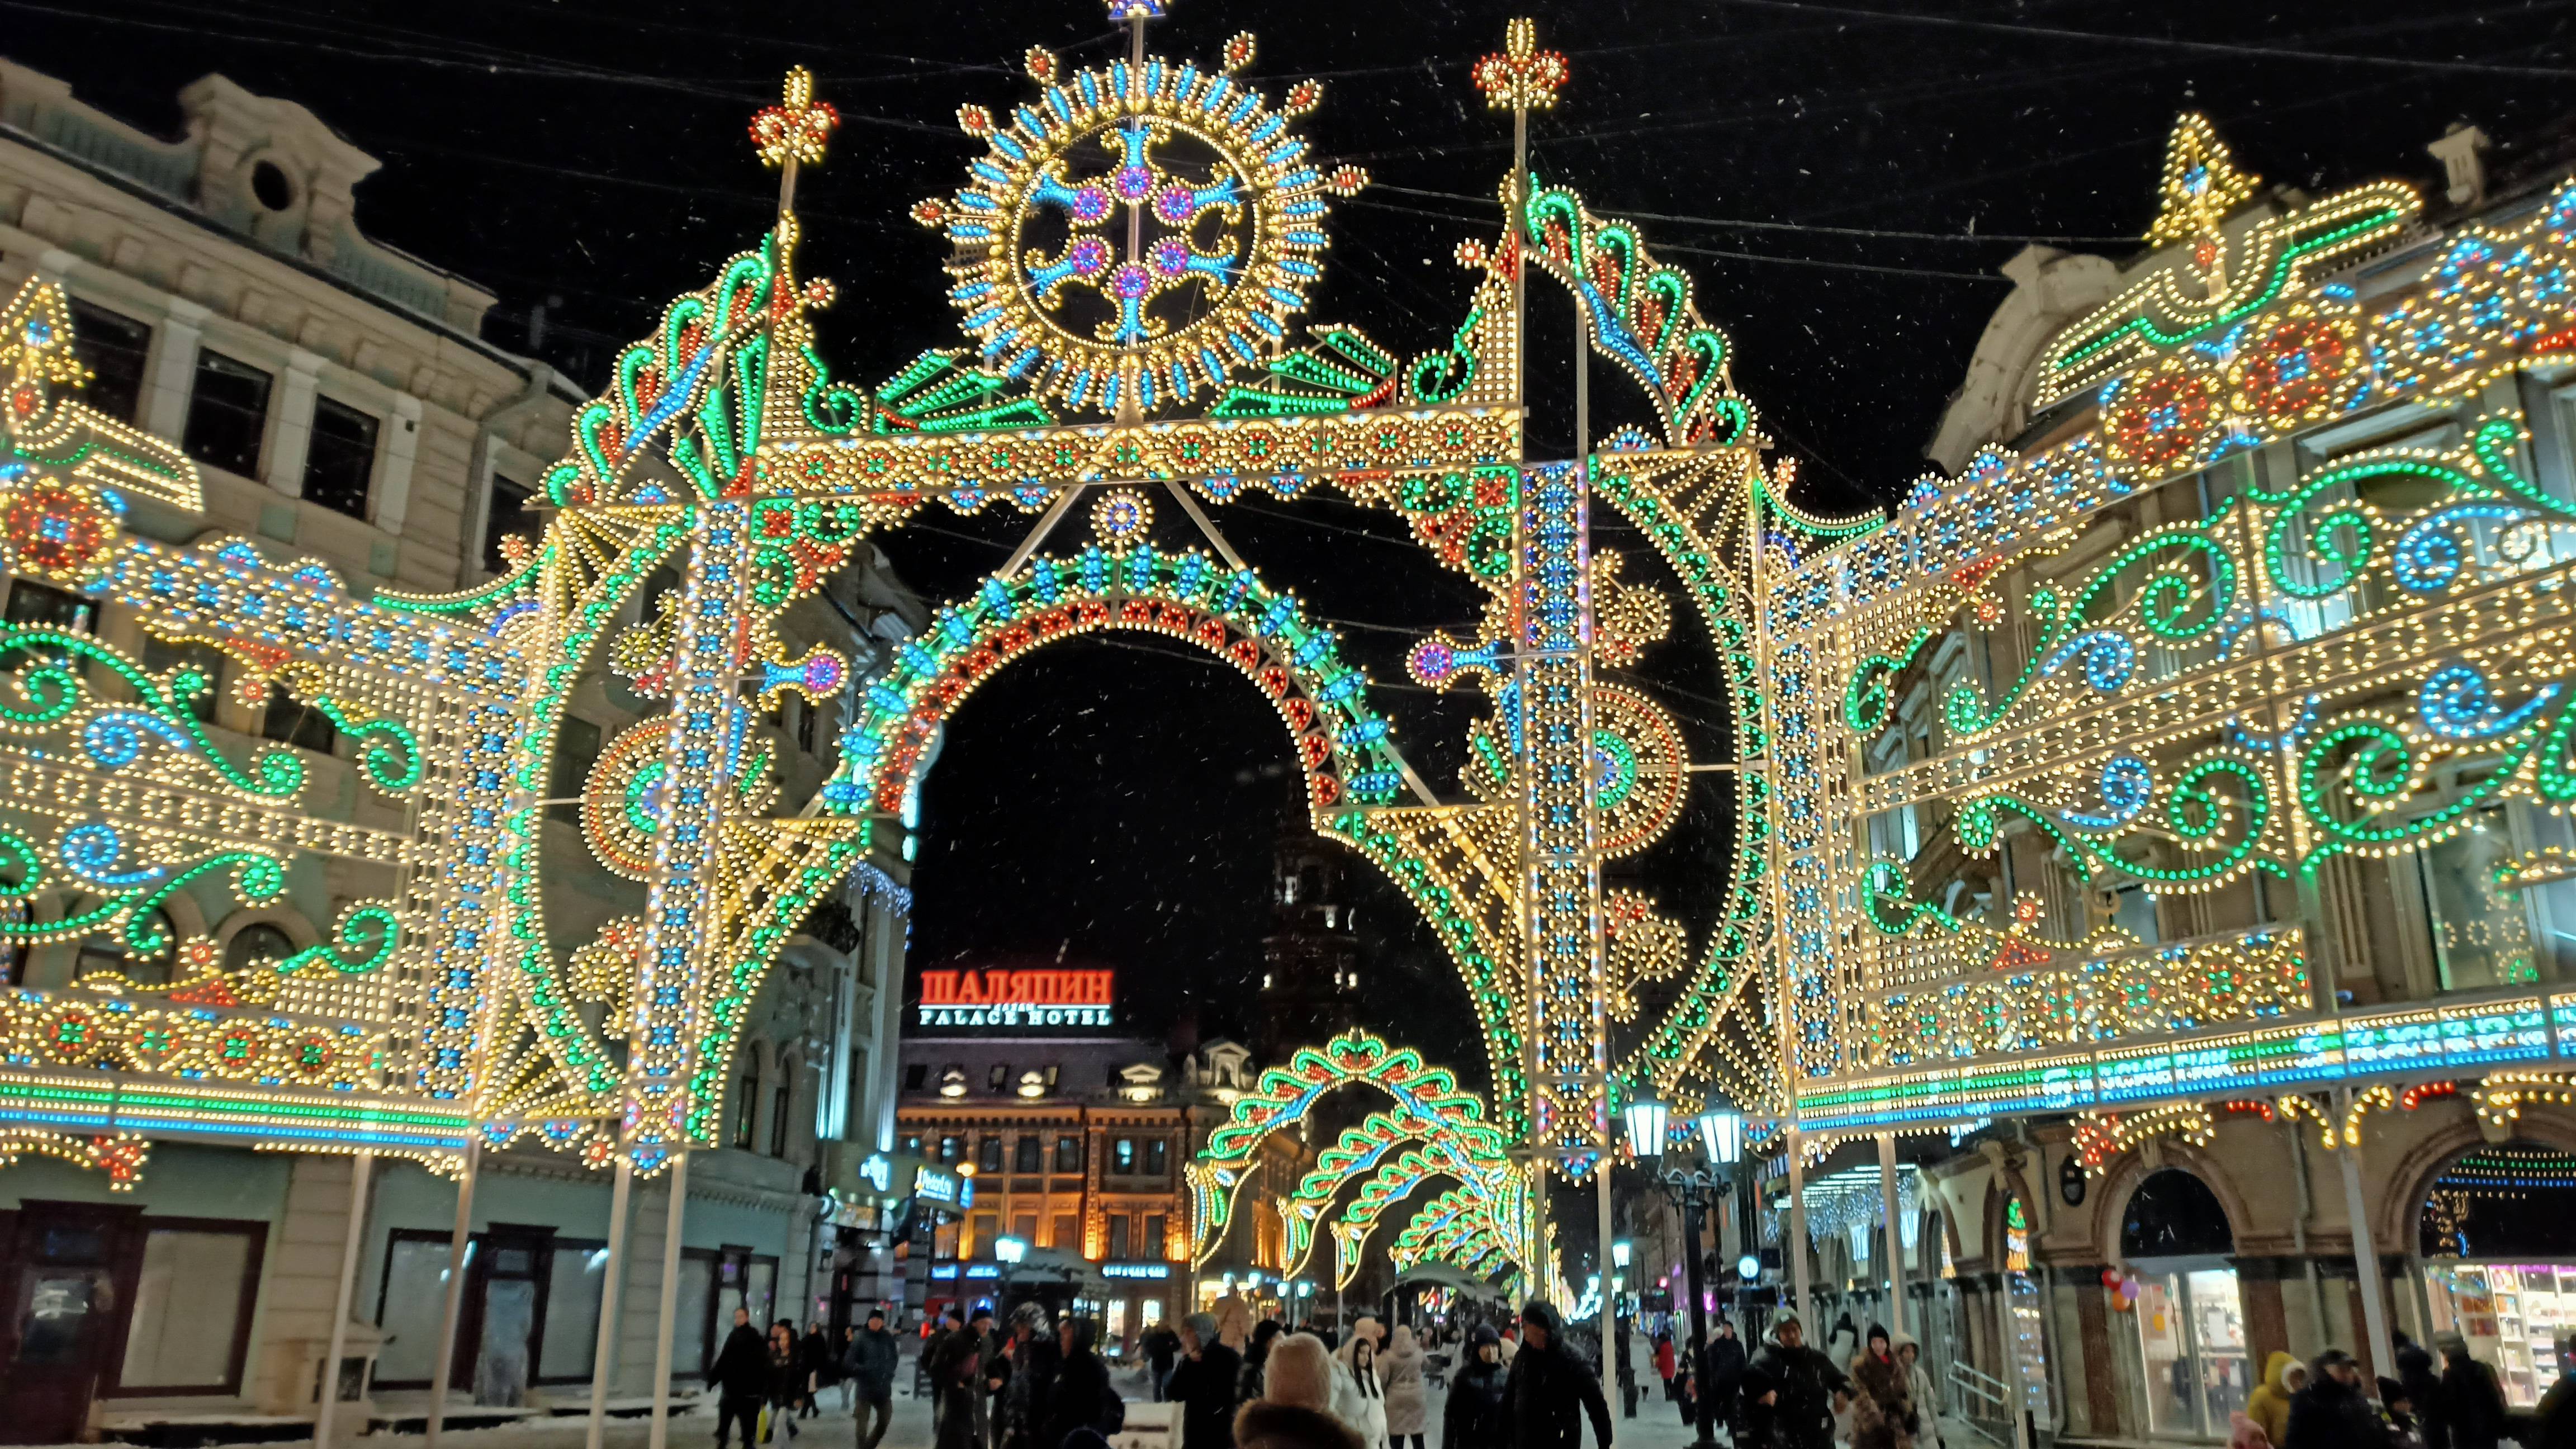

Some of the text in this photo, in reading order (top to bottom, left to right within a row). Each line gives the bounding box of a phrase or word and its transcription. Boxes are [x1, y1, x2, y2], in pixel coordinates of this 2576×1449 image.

[921, 969, 1113, 1004] ШАЛЯПИН
[920, 1010, 1110, 1025] PALACE HOTEL
